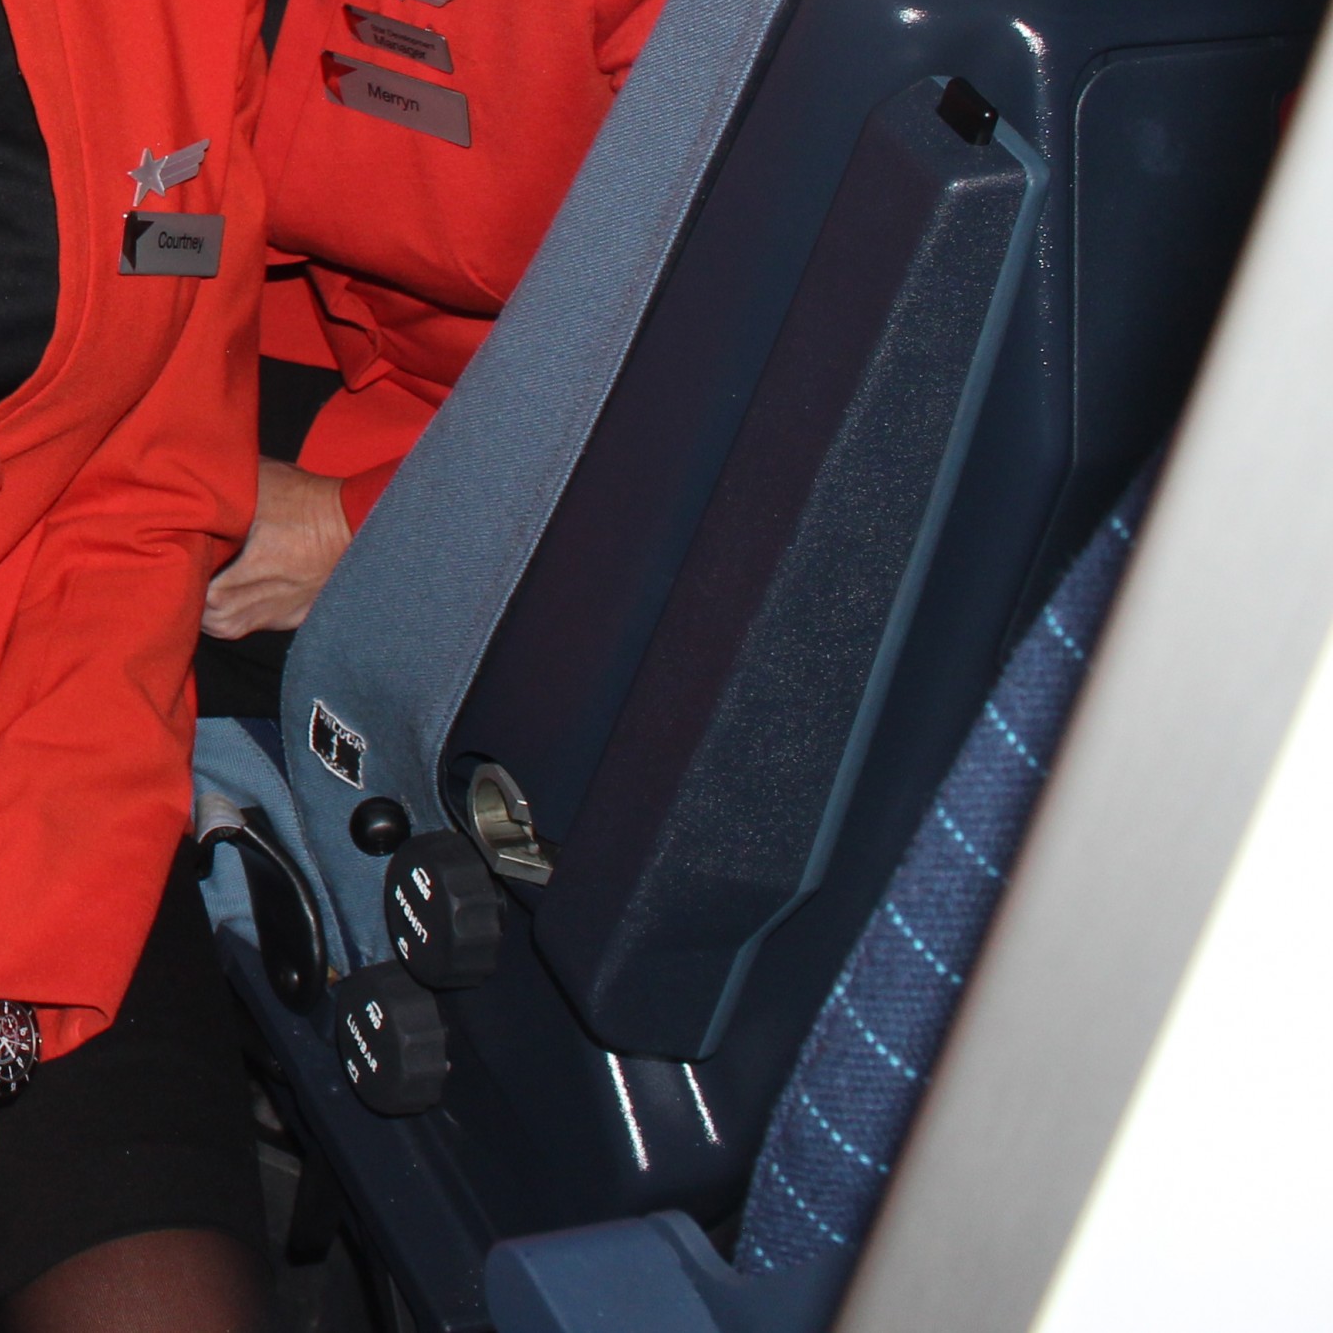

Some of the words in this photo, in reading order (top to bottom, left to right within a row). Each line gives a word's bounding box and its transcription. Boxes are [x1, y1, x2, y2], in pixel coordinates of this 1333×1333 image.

[373, 33, 426, 60] Manager
[367, 82, 420, 112] Merryn
[158, 231, 205, 254] Courtney
[395, 884, 428, 943] LUMBAR
[347, 1013, 378, 1073] LUMBAR
